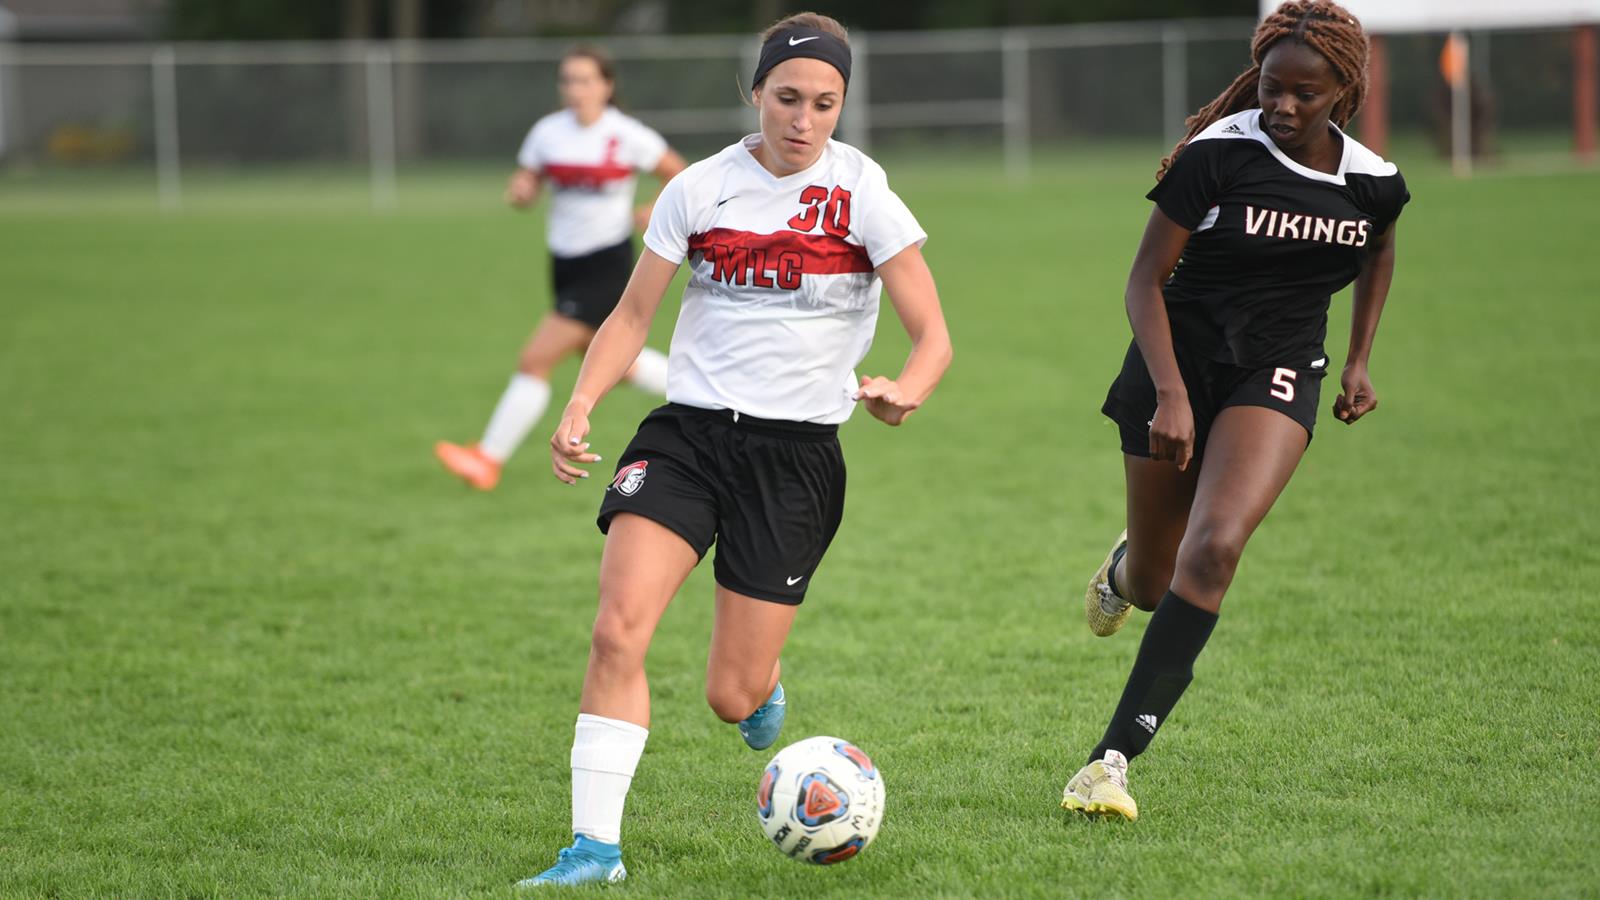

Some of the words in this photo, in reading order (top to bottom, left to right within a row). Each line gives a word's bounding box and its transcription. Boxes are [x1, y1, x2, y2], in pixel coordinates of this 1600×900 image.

[787, 184, 851, 238] 30
[1245, 205, 1368, 247] VIKINGS
[711, 243, 803, 290] MLC
[1270, 367, 1297, 402] 5
